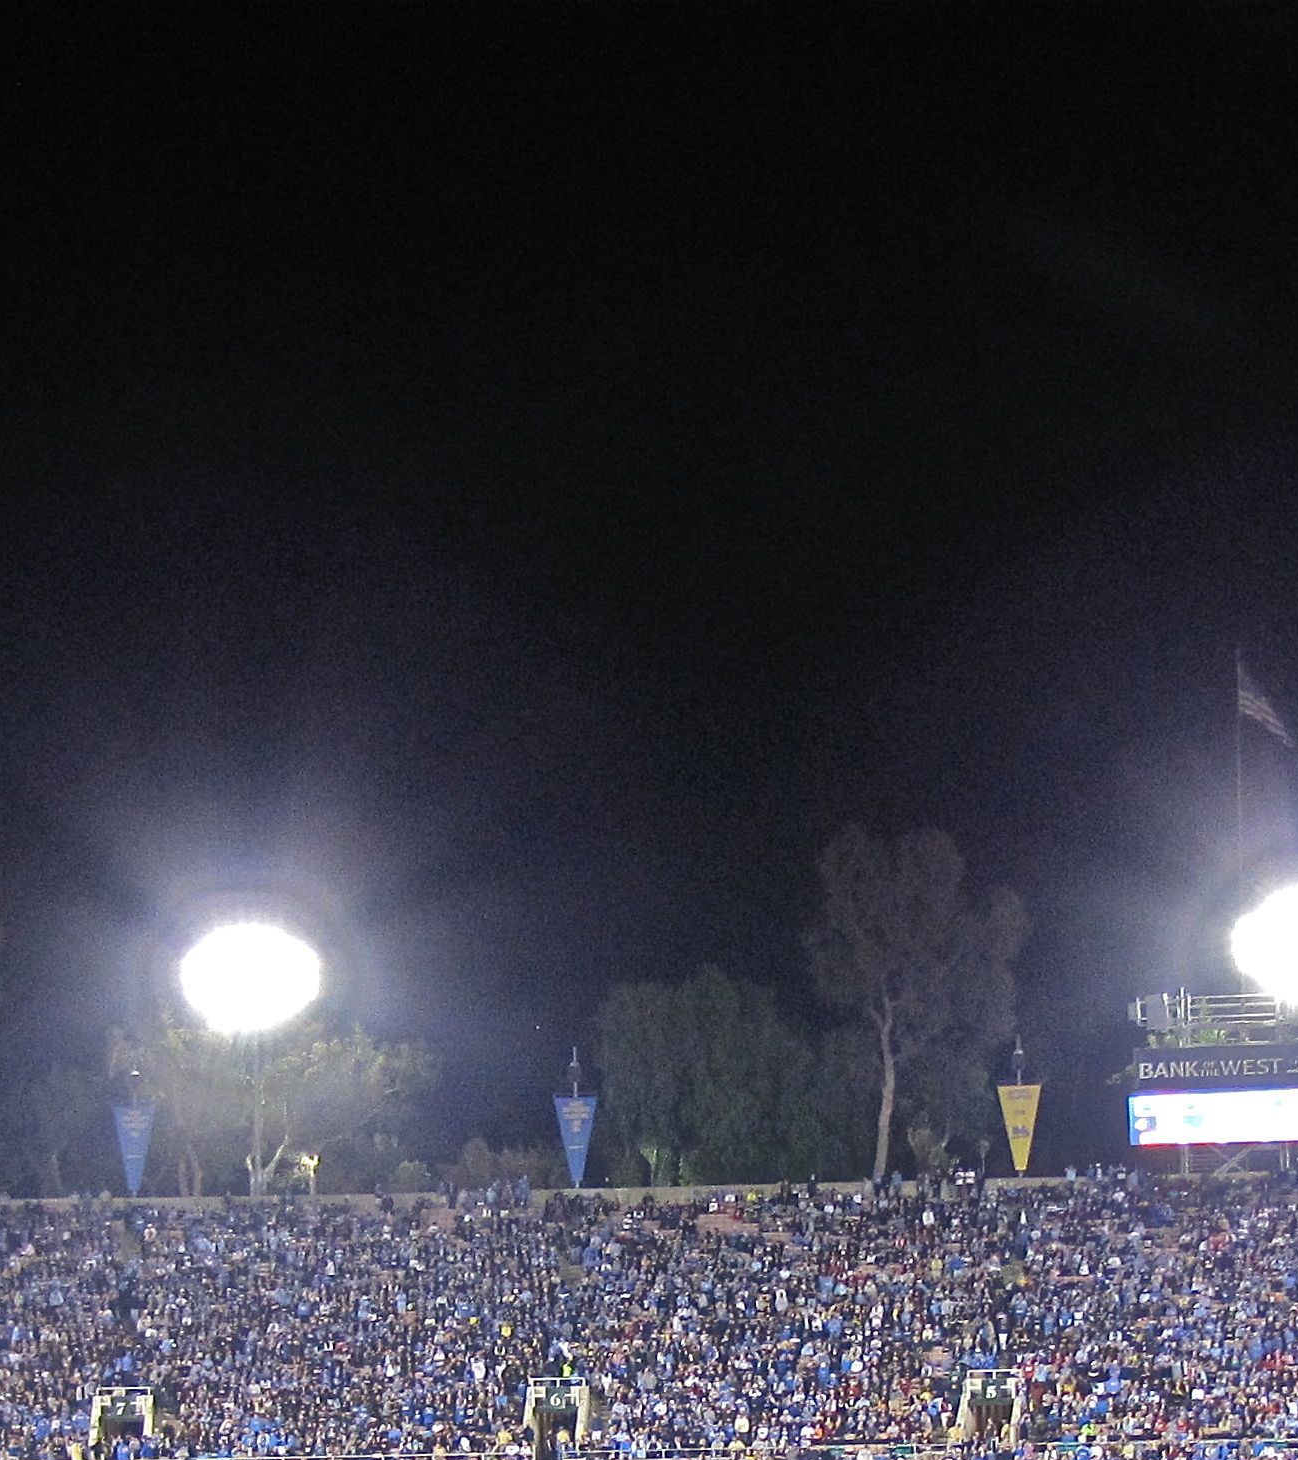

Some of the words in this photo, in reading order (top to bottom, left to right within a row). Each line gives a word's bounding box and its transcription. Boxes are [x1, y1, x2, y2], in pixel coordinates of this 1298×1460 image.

[1138, 1061, 1199, 1080] BANK
[1219, 1058, 1284, 1076] WEST
[548, 1392, 559, 1406] 6
[983, 1386, 994, 1399] 5
[113, 1402, 125, 1415] 7
